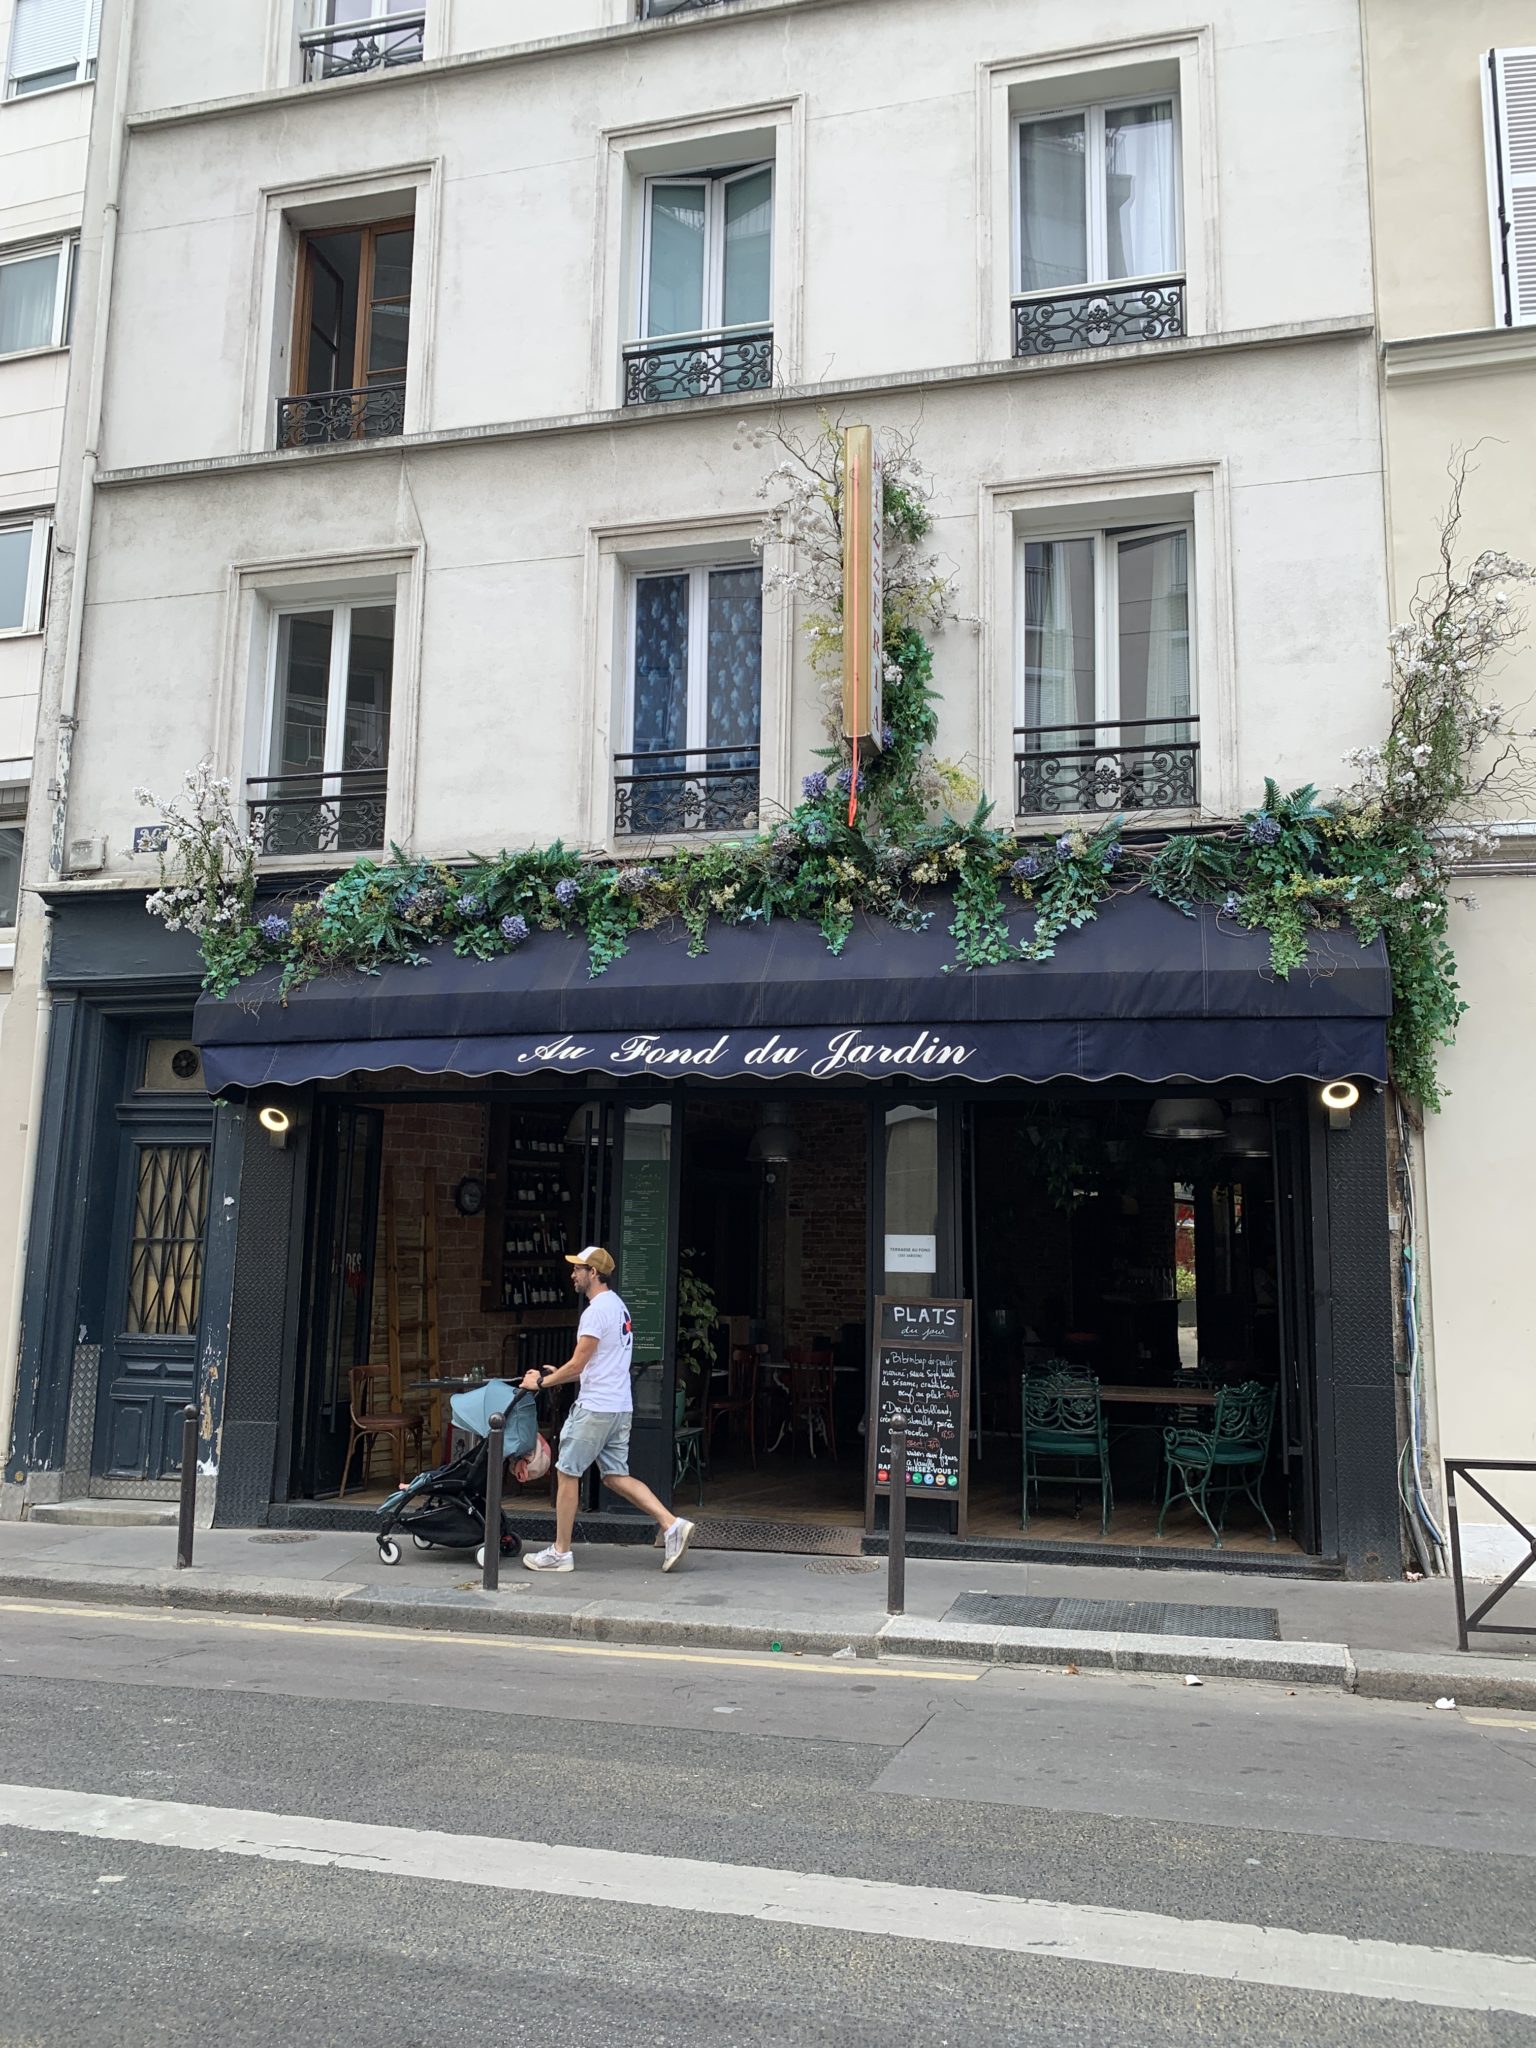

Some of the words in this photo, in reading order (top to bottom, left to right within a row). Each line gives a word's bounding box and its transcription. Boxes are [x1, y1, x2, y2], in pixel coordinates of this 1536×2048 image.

[518, 1035, 594, 1063] Au
[611, 1035, 730, 1065] Fond
[744, 1034, 808, 1065] du
[810, 1029, 978, 1077] Jardin
[893, 1306, 956, 1326] PLATS
[901, 1326, 918, 1335] du
[922, 1327, 945, 1341] jour
